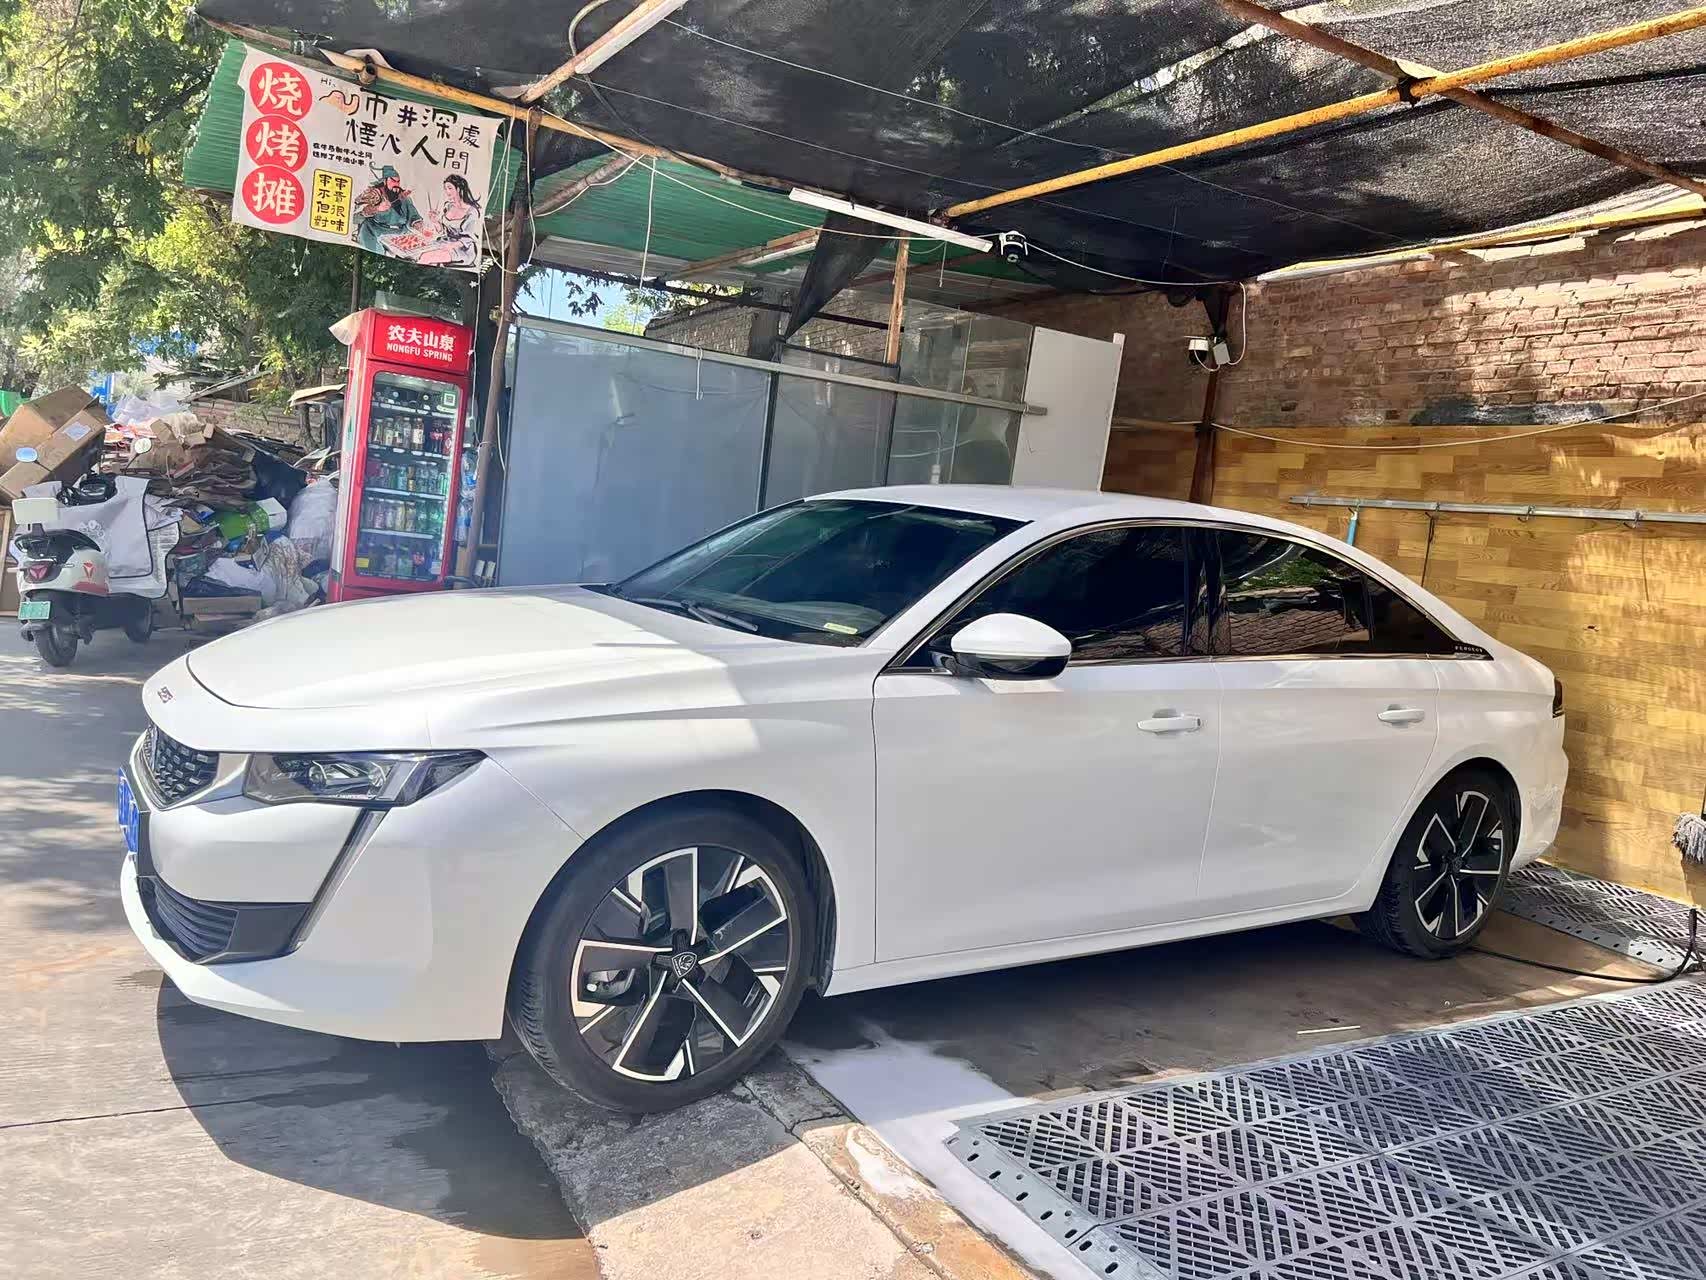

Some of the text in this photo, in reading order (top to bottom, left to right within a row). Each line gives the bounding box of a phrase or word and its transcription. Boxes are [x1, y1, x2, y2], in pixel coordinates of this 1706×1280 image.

[253, 67, 303, 217] 烧烤摊
[386, 342, 453, 362] NONGFU SPRING
[387, 324, 454, 352] 农夫山泉
